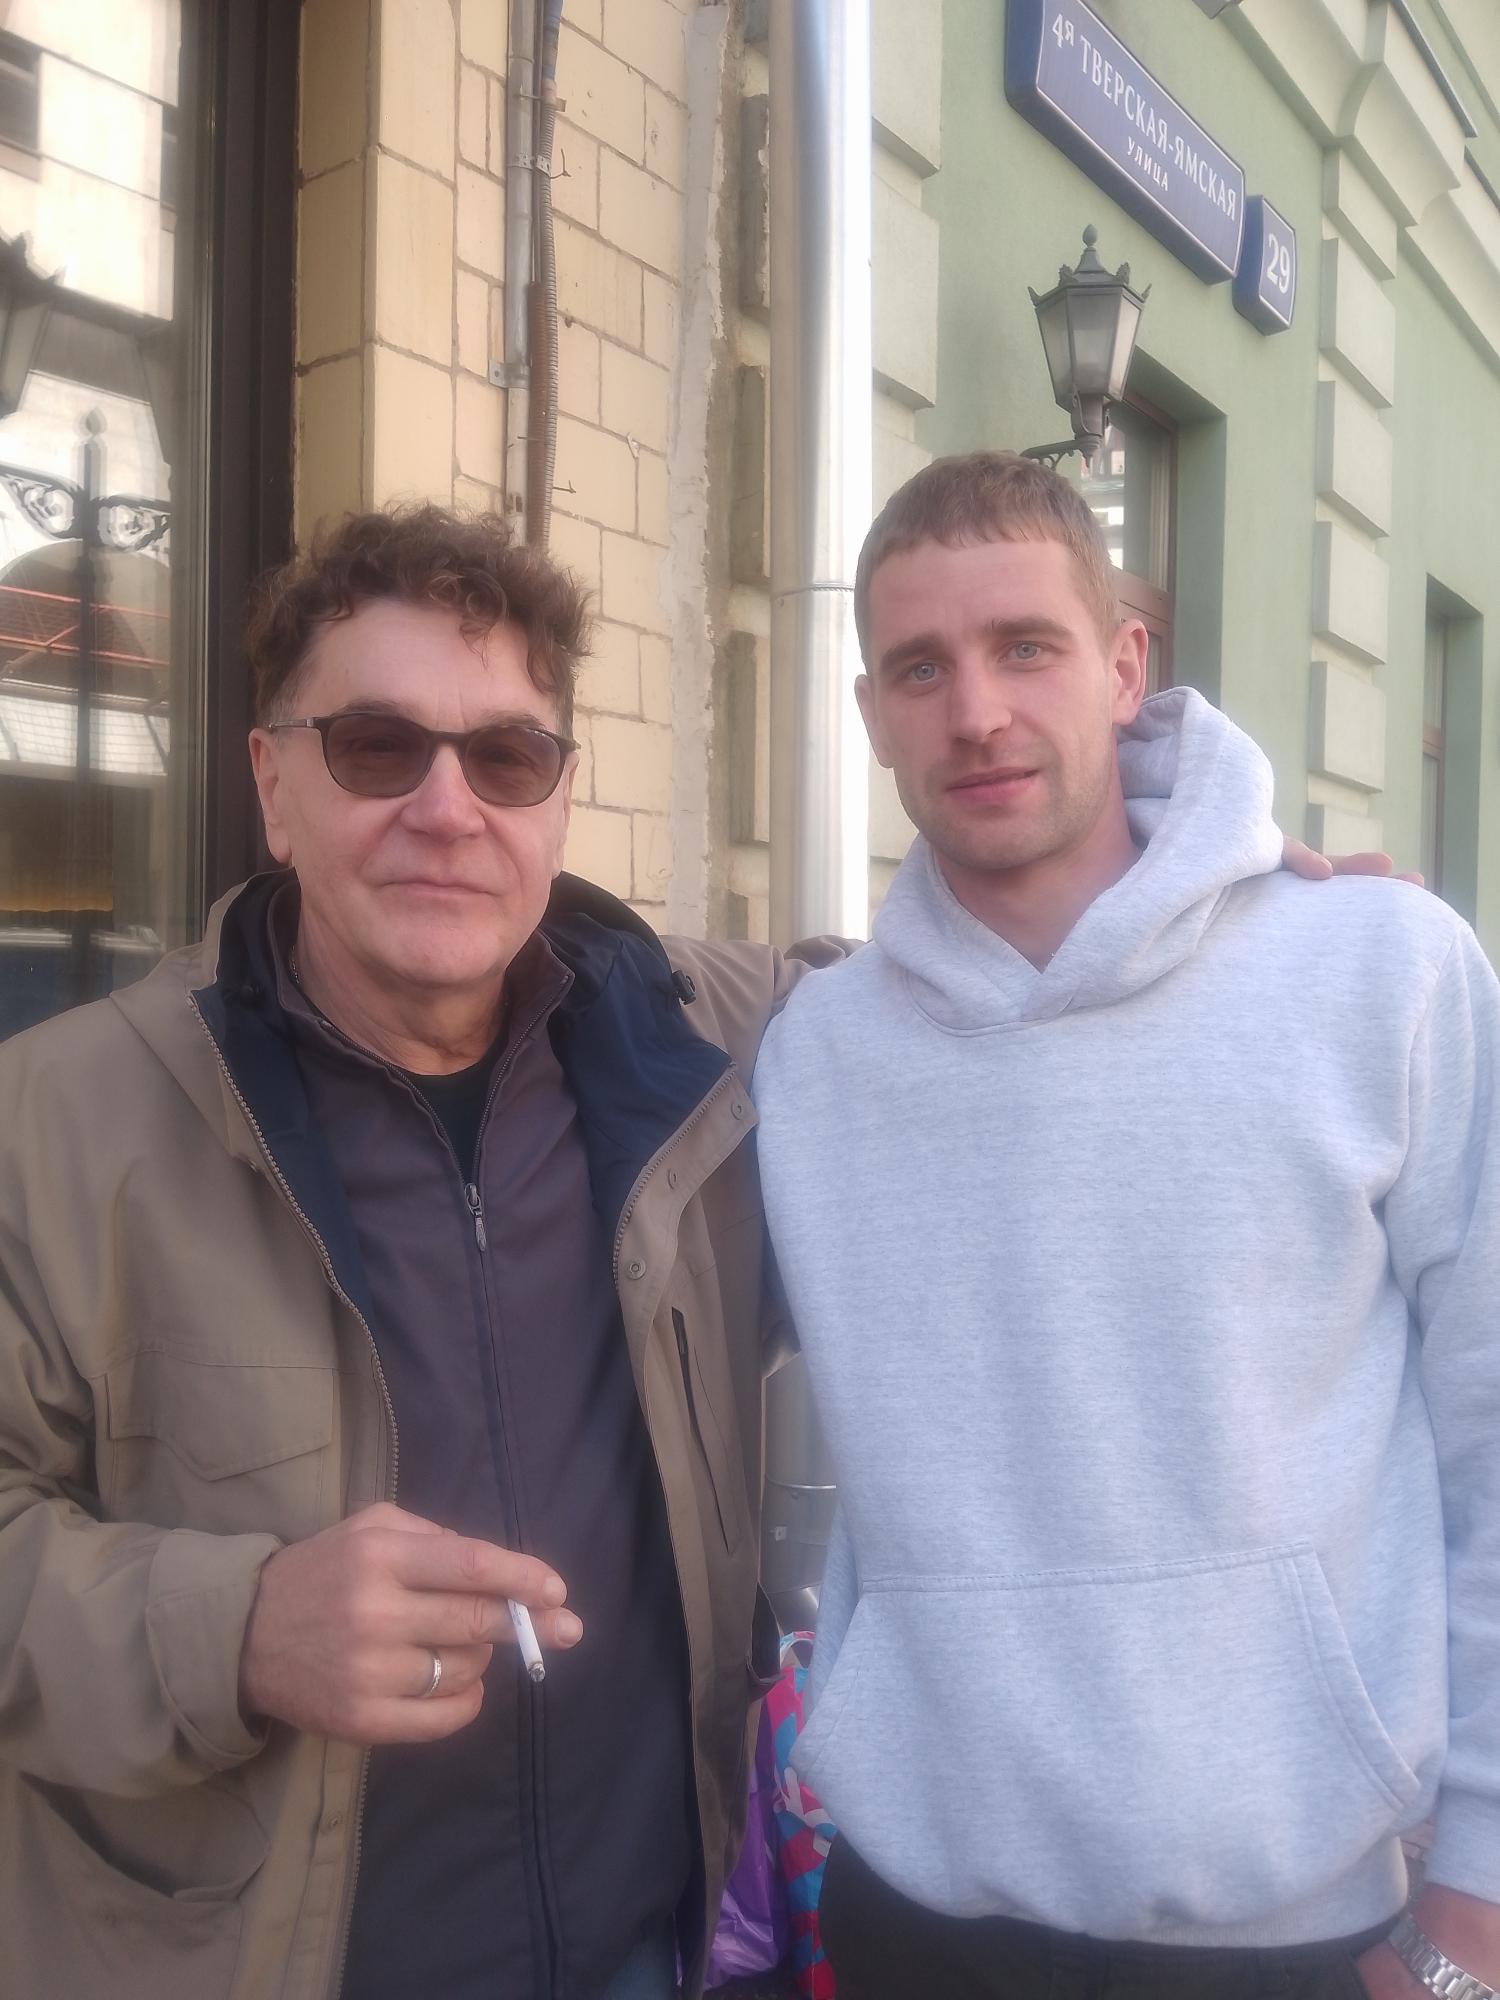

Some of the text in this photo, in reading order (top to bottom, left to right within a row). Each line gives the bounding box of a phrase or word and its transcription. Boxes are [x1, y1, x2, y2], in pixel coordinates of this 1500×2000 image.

[1080, 35, 1236, 221] ТВЕРСКАЯ-ЯМСКАЯ
[1127, 136, 1169, 191] УЛИЦА
[1267, 233, 1291, 294] 29
